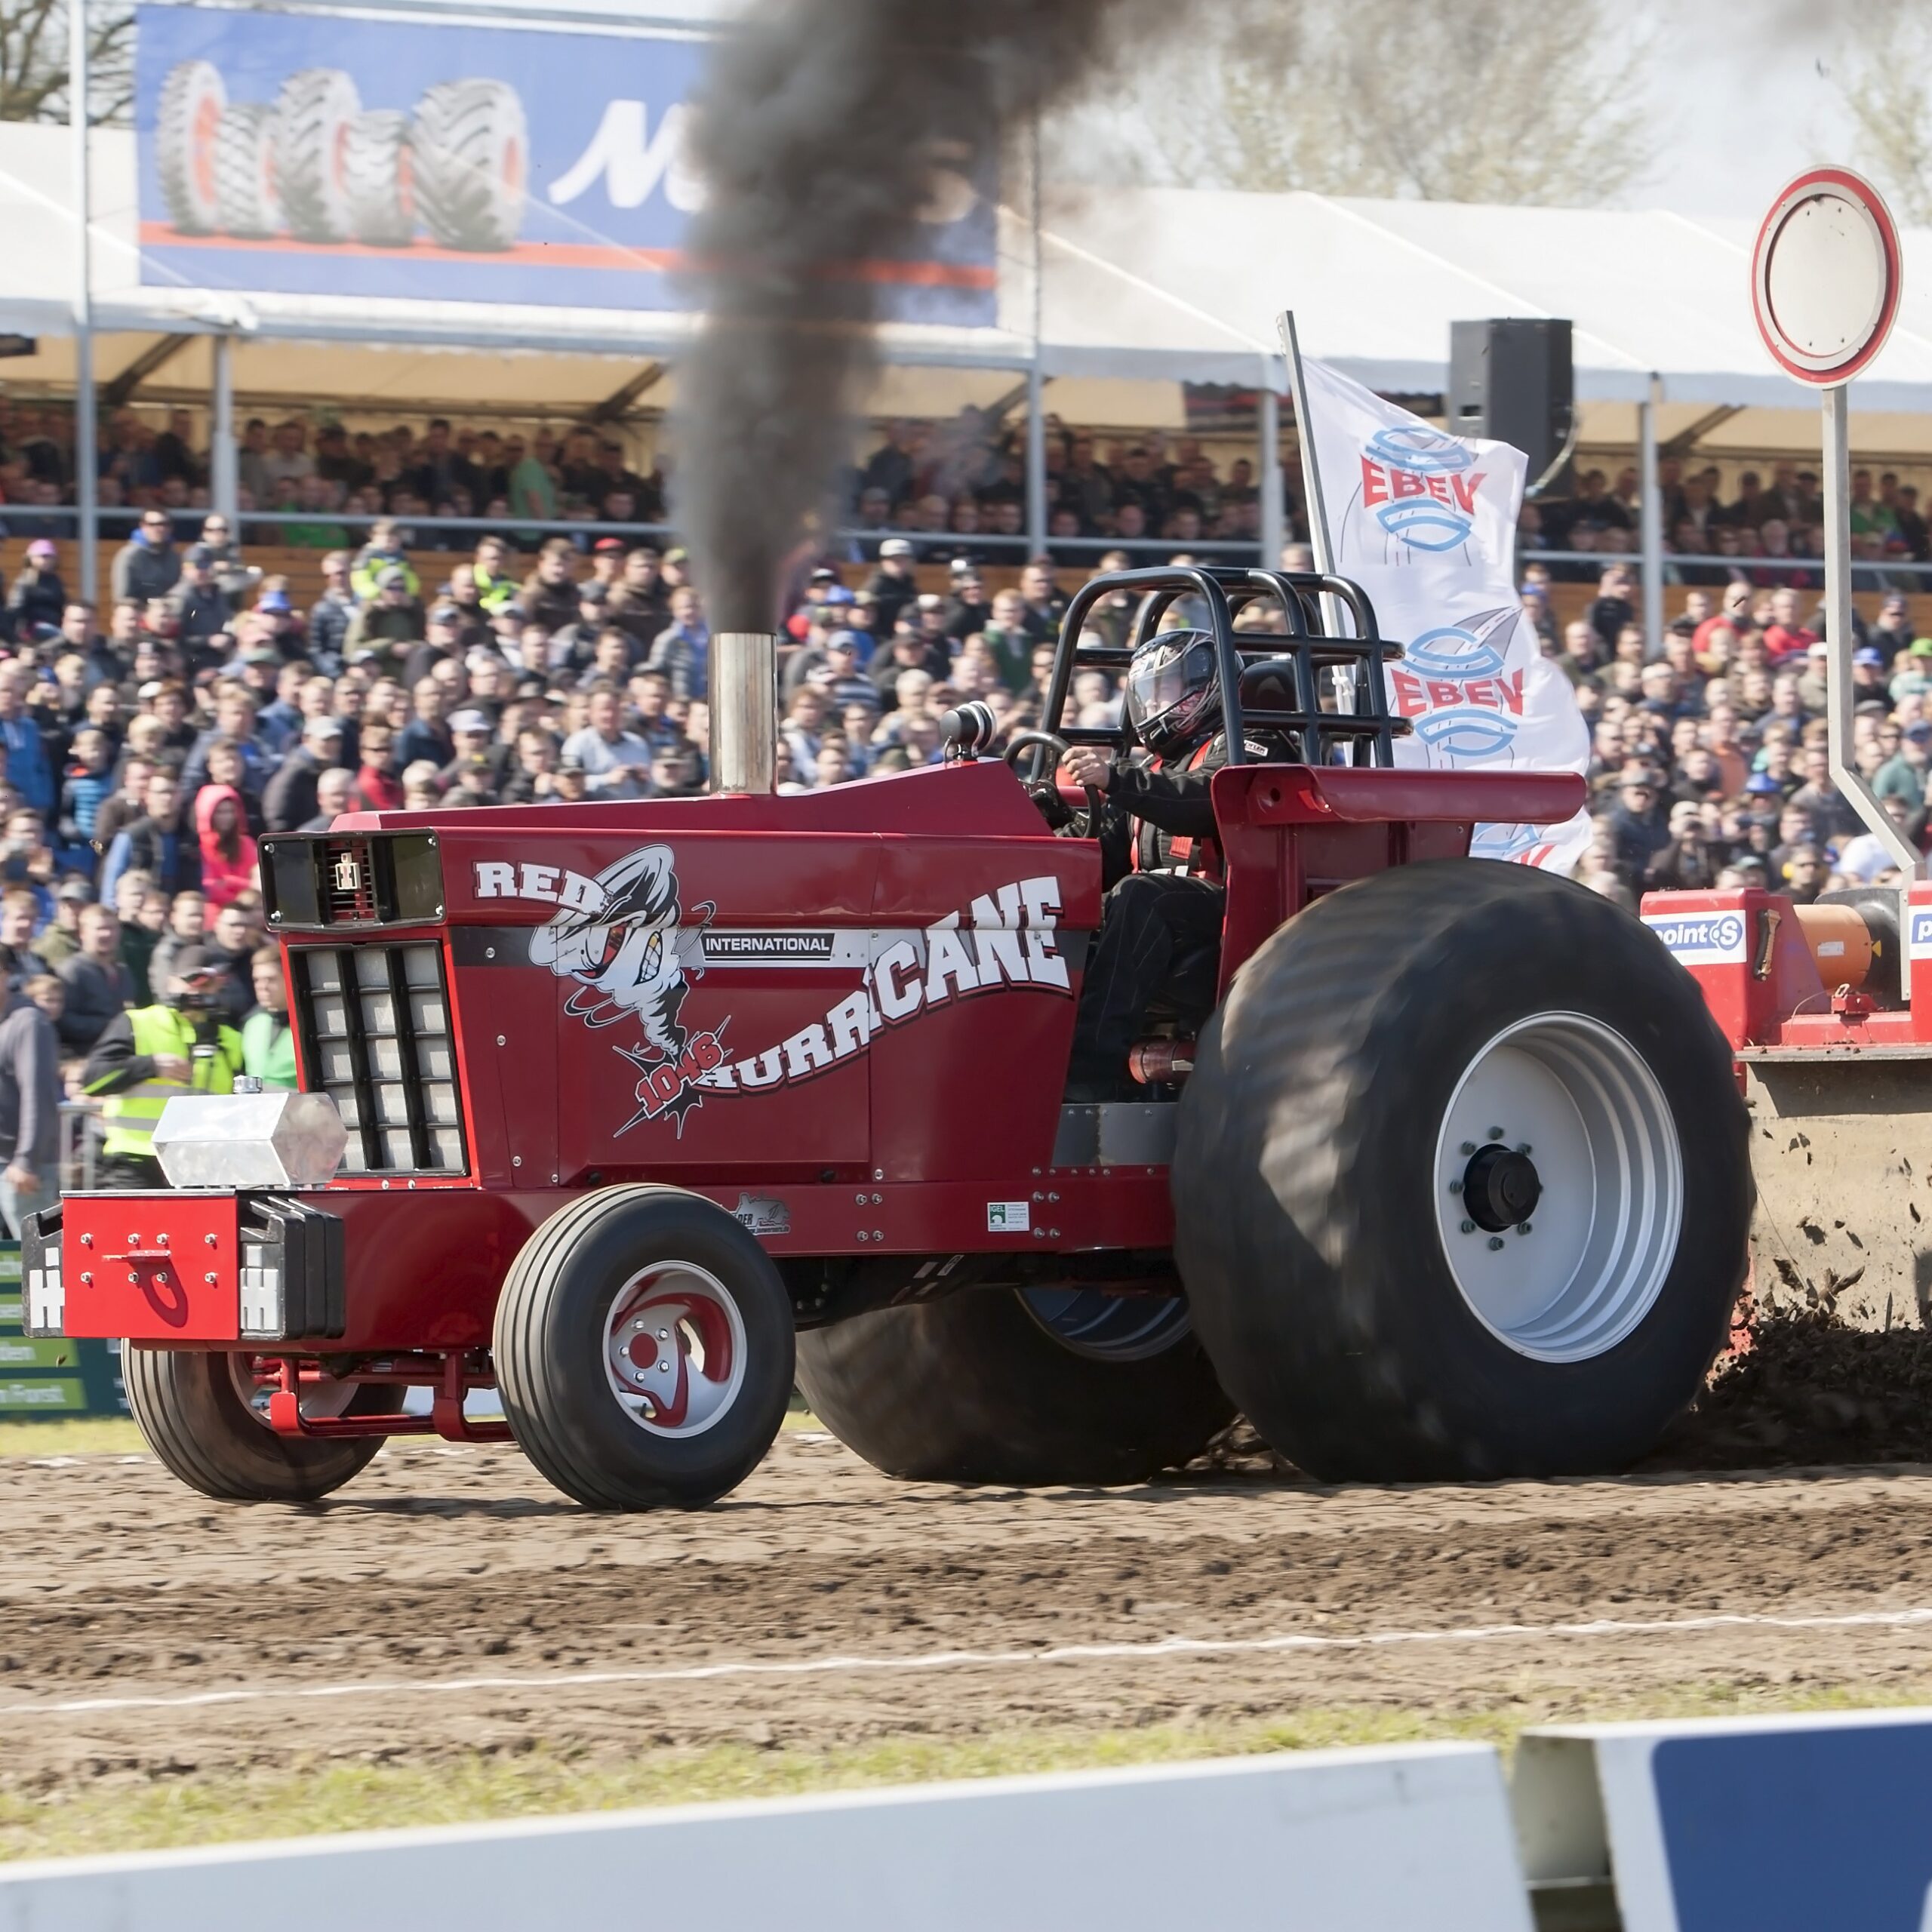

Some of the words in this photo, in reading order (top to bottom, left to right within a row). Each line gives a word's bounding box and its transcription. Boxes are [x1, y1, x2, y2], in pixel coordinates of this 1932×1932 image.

[1360, 454, 1487, 516] EBEV
[1390, 667, 1524, 717] EBEV
[474, 862, 608, 915] RED
[706, 937, 830, 952] INTERNATIONAL
[635, 1032, 725, 1118] 1046
